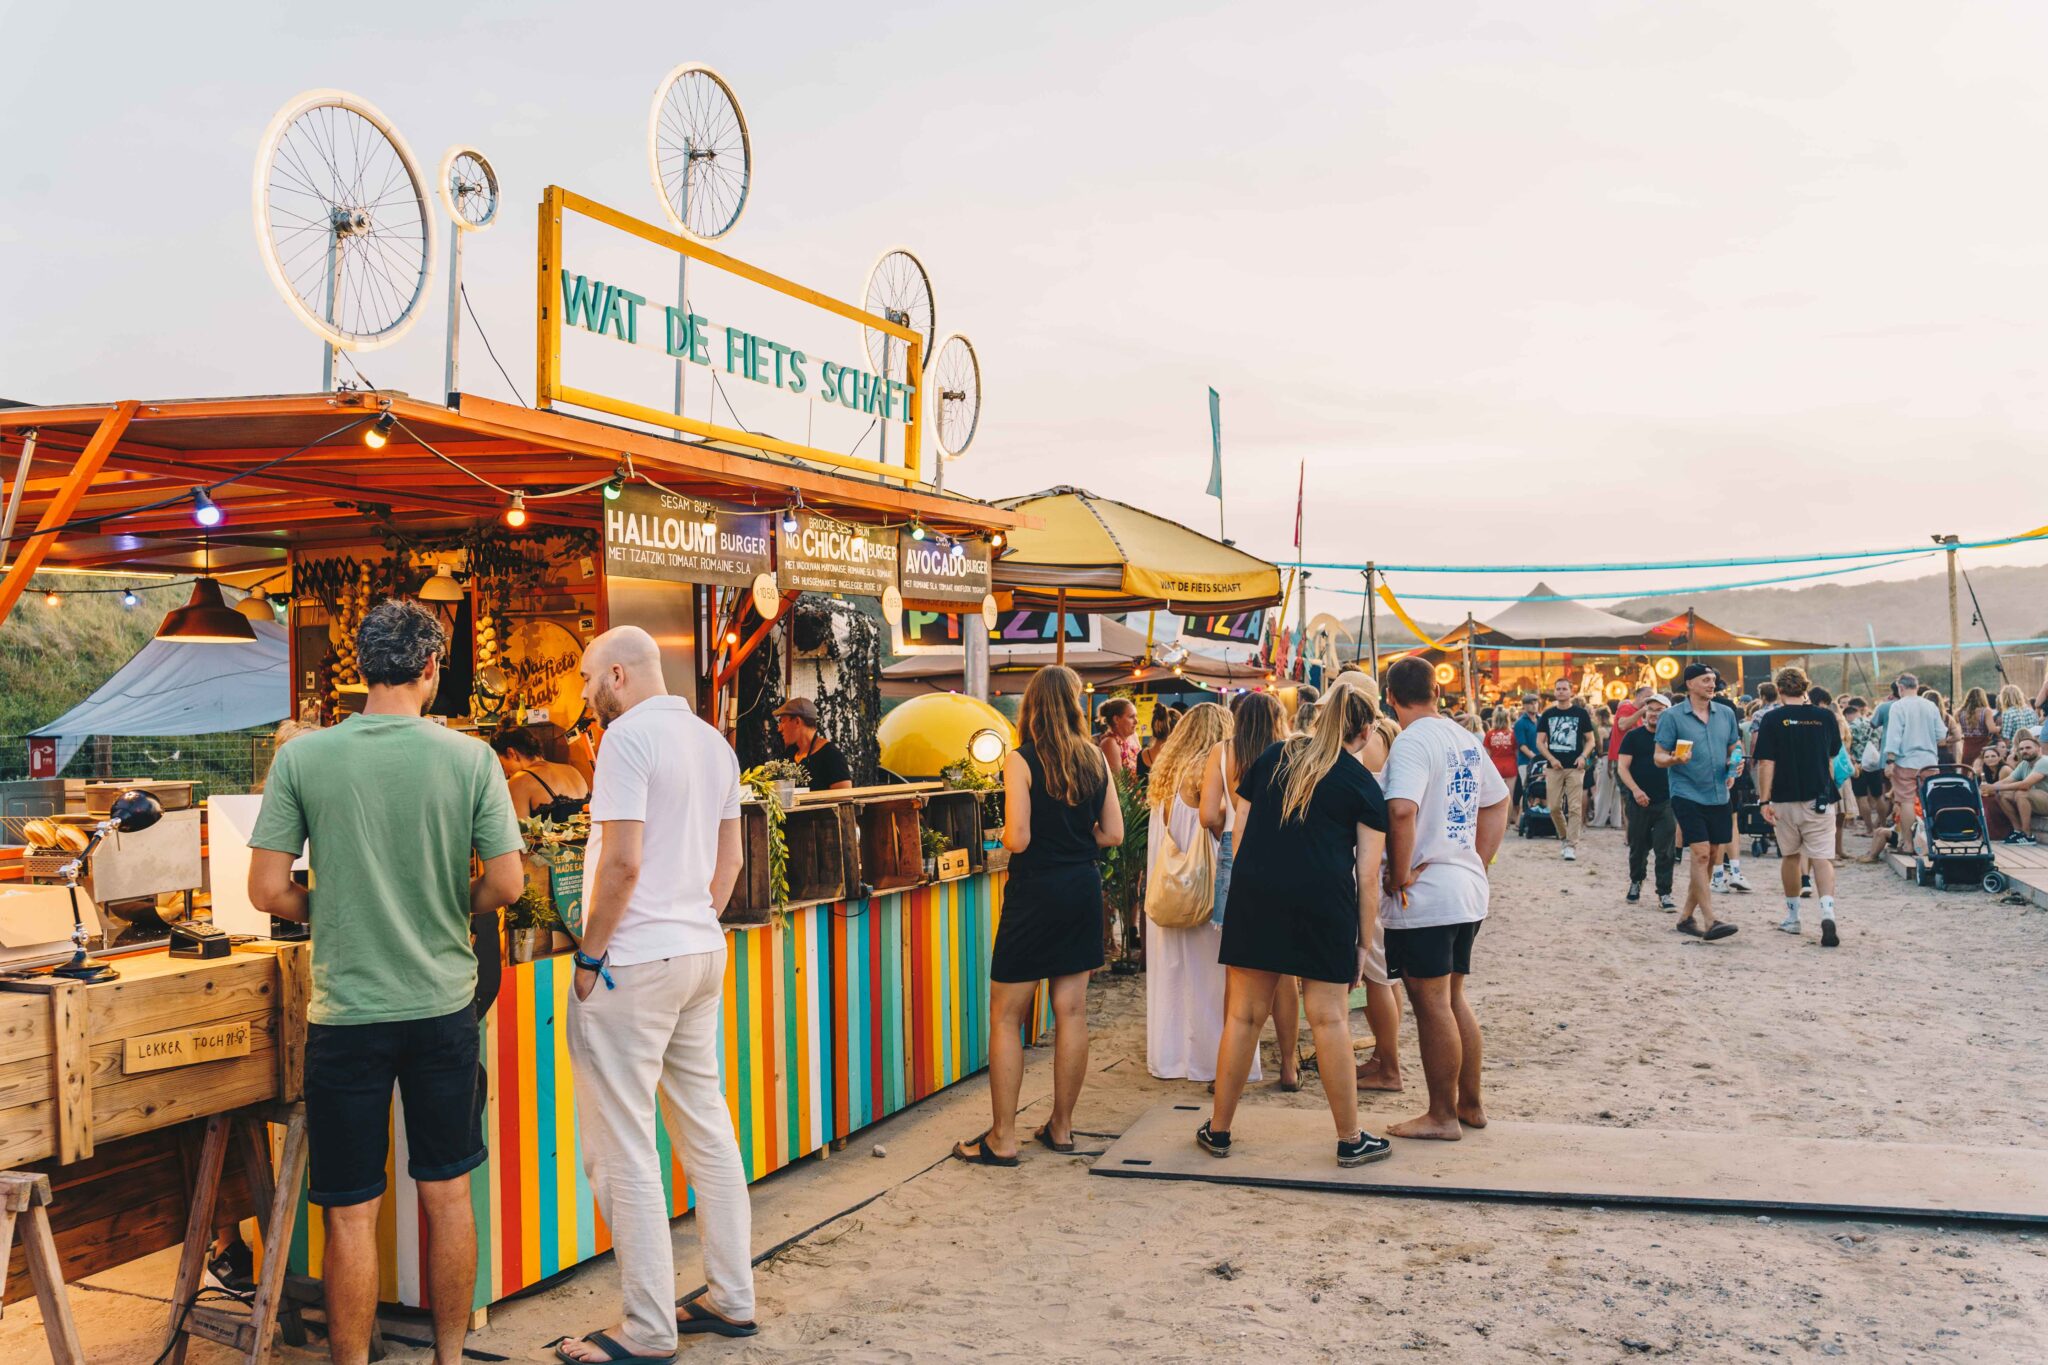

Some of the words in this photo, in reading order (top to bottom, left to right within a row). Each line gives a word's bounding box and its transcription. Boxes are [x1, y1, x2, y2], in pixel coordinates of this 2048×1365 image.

[560, 268, 646, 344] WAT
[666, 305, 709, 366] DE
[727, 327, 807, 394] FIETS
[822, 361, 916, 423] SCHAFT
[660, 494, 690, 511] SESAM
[607, 509, 716, 555] HALLOUMI
[720, 532, 767, 556] BURGER
[808, 517, 835, 532] BRIOCHE
[785, 533, 800, 551] NO
[802, 529, 869, 564] CHICKEN
[868, 543, 897, 562] BURGER
[608, 546, 627, 561] MET
[630, 548, 666, 567] TZATZIKI,
[667, 553, 699, 571] TOMAAT,
[700, 557, 733, 574] ROMAINE
[736, 561, 751, 574] SLA
[785, 560, 796, 570] MET
[905, 548, 967, 578] AVOCADO
[966, 559, 989, 575] BURGER
[792, 576, 800, 585] EN
[903, 579, 912, 588] MET
[1161, 581, 1176, 590] WAT
[1178, 582, 1189, 592] DE
[1191, 582, 1211, 593] FIETS
[1213, 583, 1241, 593] SCHAFT
[909, 610, 1084, 640] PIZA
